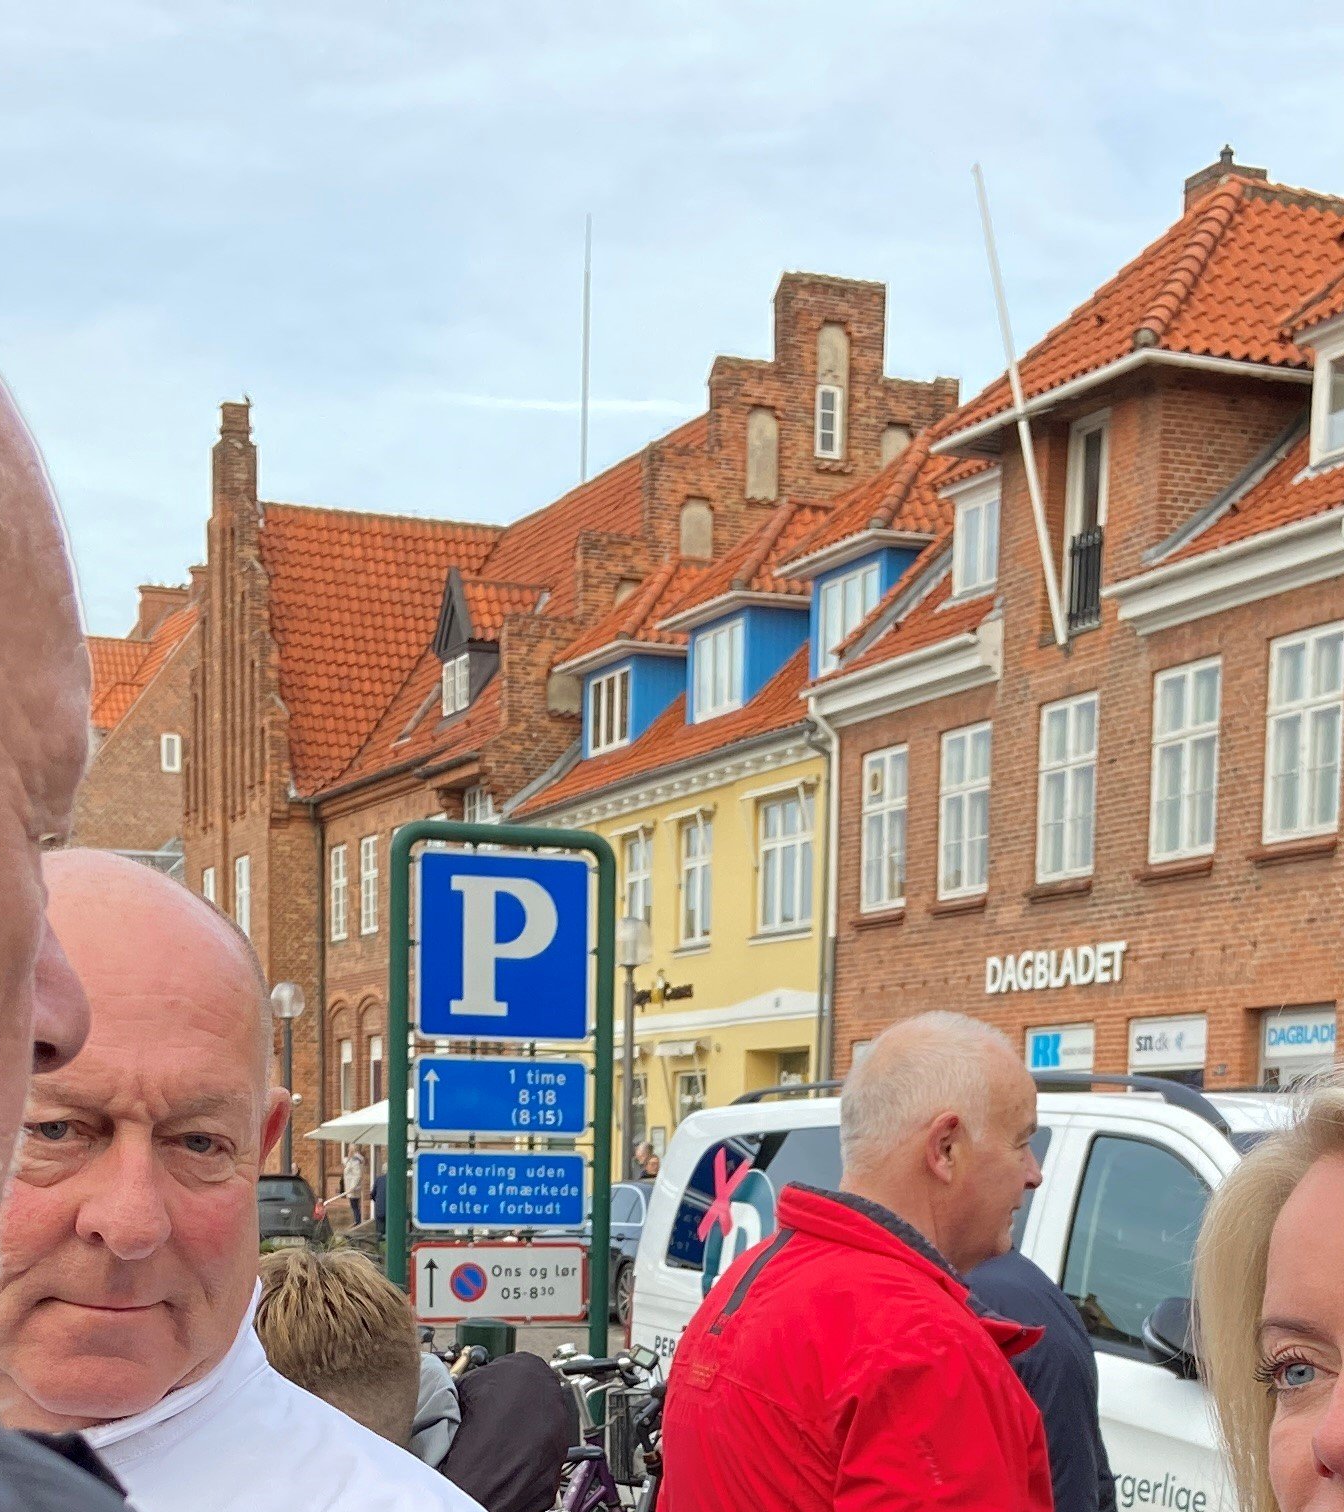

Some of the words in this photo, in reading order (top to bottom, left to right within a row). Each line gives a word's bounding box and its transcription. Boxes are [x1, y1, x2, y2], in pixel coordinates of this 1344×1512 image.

[450, 875, 558, 1017] P
[985, 940, 1128, 994] DAGBLADET
[509, 1069, 516, 1085] 1
[527, 1069, 567, 1086] time
[518, 1089, 557, 1105] 8-18
[511, 1107, 563, 1126] (8-15)
[437, 1162, 517, 1180] Parkering
[526, 1164, 565, 1178] uden
[423, 1181, 448, 1195] for
[458, 1182, 477, 1196] de
[487, 1182, 579, 1197] afmærkede
[441, 1200, 490, 1214] felter
[499, 1200, 561, 1215] forbudt
[491, 1264, 522, 1278] Ons
[529, 1267, 548, 1280] og
[555, 1264, 577, 1277] lør
